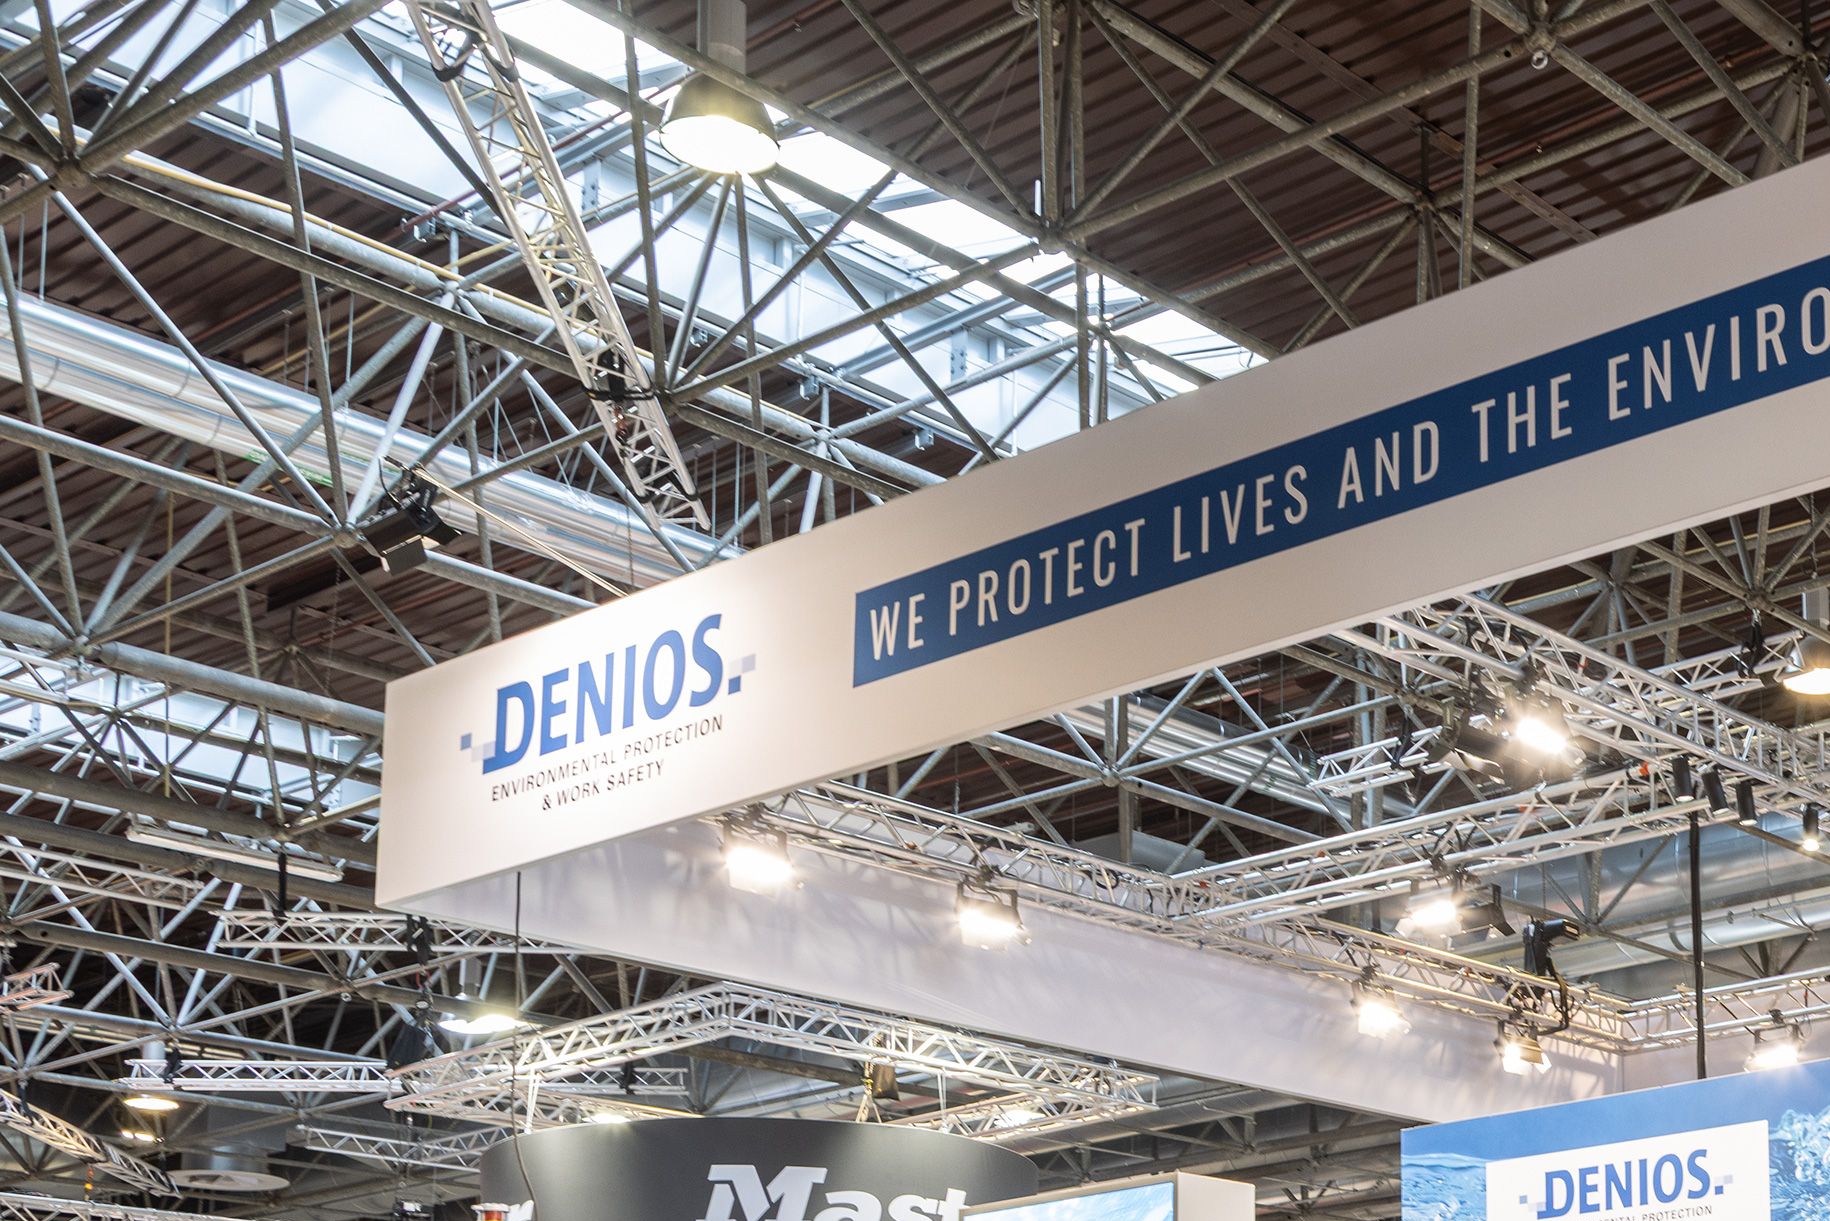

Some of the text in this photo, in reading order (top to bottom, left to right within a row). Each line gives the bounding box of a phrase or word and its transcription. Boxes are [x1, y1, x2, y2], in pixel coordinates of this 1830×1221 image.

[869, 593, 925, 661] WE
[950, 518, 1145, 636] PROTECT
[1173, 464, 1308, 562] LIVES
[1338, 420, 1440, 509] AND
[1472, 373, 1572, 462] THE
[492, 714, 723, 802] ENVIRONMENTAL PROTECTION
[541, 759, 664, 811] & WORK SAFETY
[1642, 1205, 1713, 1221] PROTECTION
